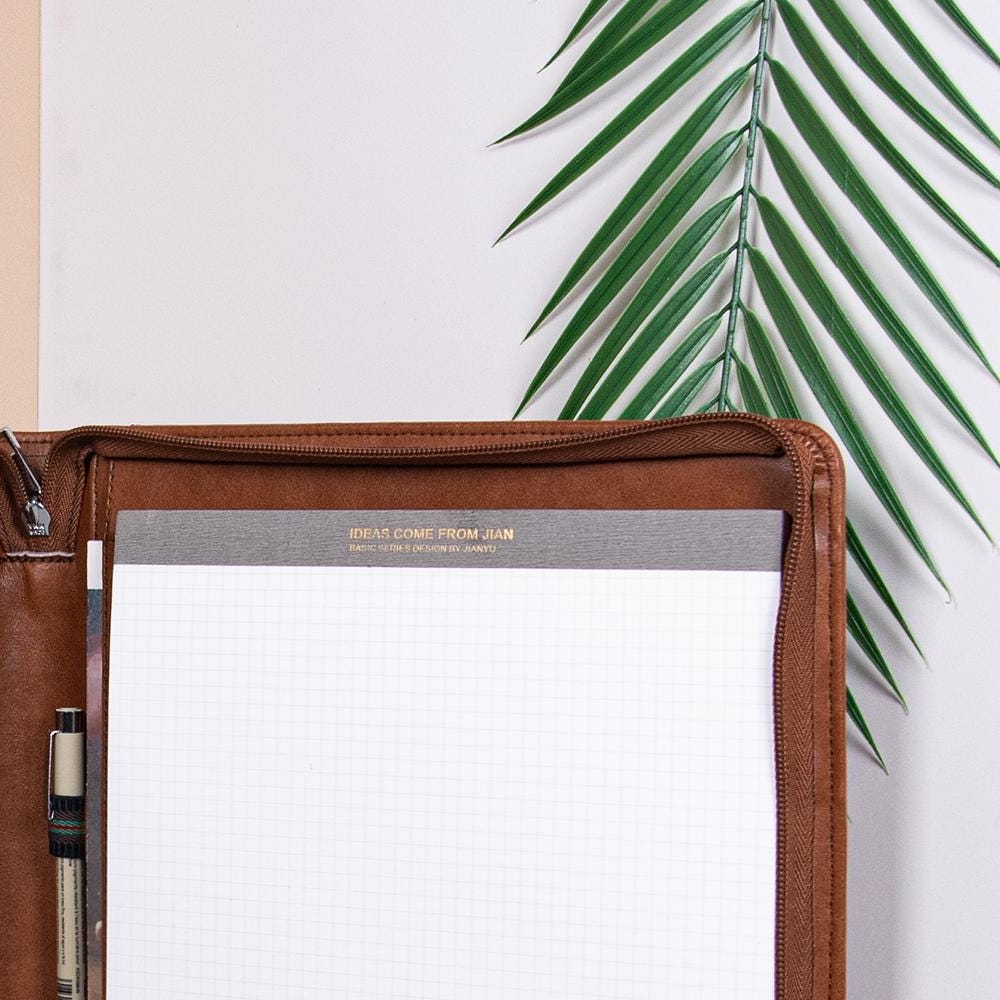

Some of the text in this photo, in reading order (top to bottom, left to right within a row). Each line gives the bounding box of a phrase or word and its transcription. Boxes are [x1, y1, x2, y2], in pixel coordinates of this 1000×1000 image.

[349, 528, 515, 540] IDEAS COME FROM JIAN
[412, 544, 447, 553] DESIGN
[448, 544, 461, 553] BY
[463, 544, 496, 553] JIANYU
